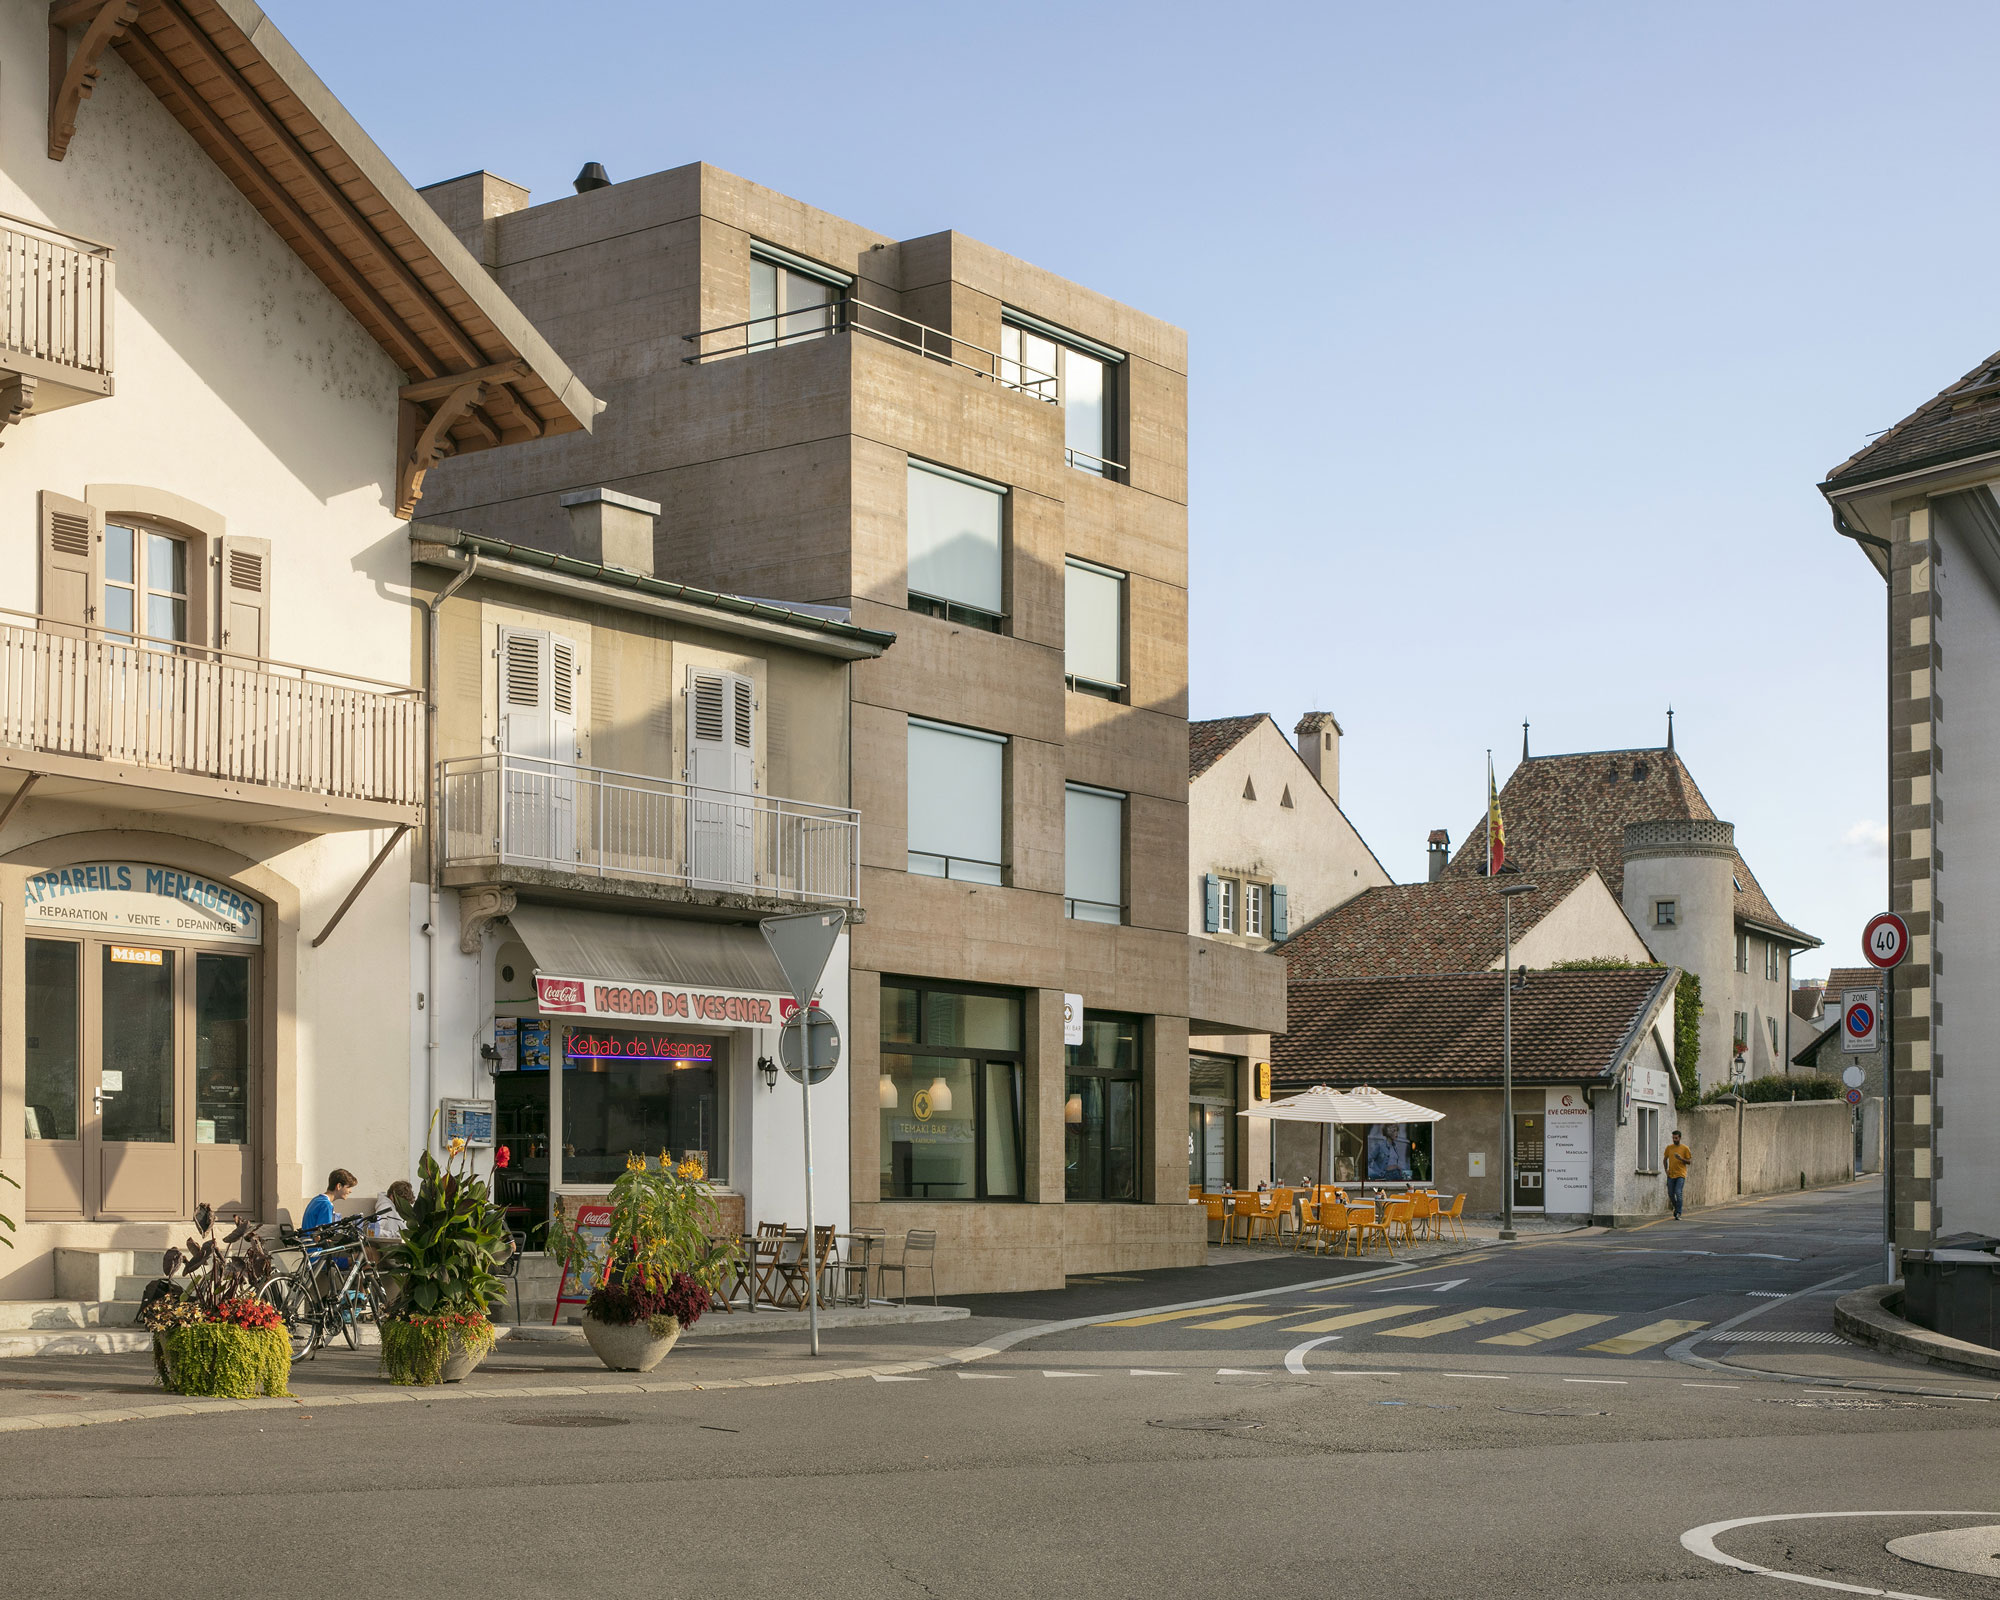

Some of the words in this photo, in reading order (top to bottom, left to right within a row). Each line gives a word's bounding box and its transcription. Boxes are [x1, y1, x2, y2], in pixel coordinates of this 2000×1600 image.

[24, 866, 132, 908] APPAREILS
[145, 868, 254, 926] MENAGERS
[39, 905, 108, 921] REPARATION
[127, 913, 161, 926] VENTE
[177, 918, 237, 933] DEPANNAGE
[1876, 931, 1895, 951] 40
[112, 948, 161, 963] Miele
[594, 986, 659, 1015] KEBAB
[662, 991, 689, 1018] DE
[691, 994, 772, 1024] VESENAZ
[567, 1034, 621, 1056] Kebab
[626, 1036, 648, 1056] de
[651, 1036, 712, 1058] Vésenaz
[900, 1124, 929, 1134] TEMAKI
[932, 1124, 946, 1134] BAR
